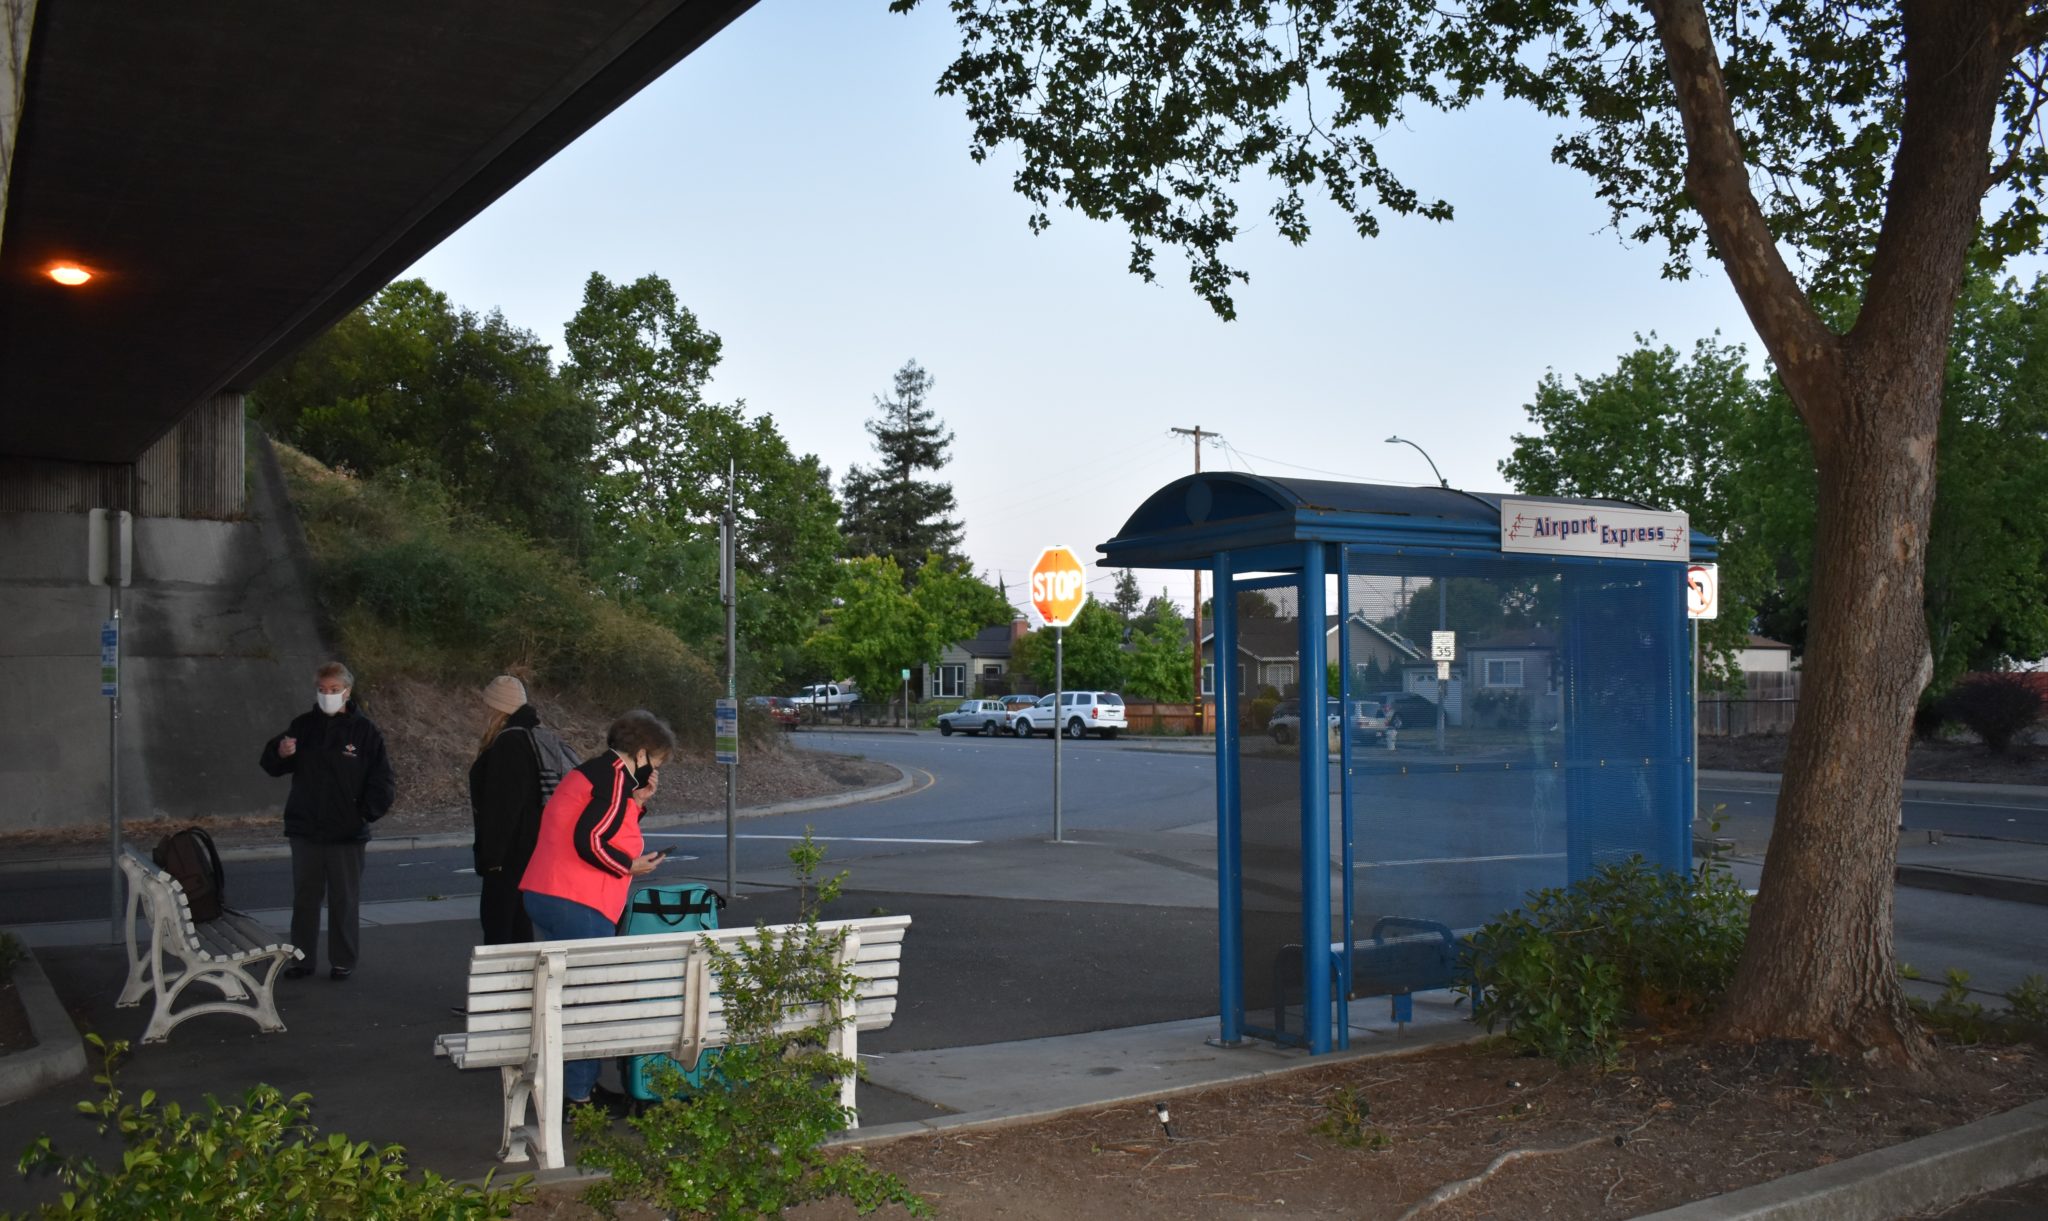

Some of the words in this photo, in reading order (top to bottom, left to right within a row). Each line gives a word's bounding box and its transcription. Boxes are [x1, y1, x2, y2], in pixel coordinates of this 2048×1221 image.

[1533, 515, 1598, 540] Airport
[1601, 524, 1665, 548] Express
[1033, 569, 1082, 602] STOP
[1436, 645, 1452, 657] 35
